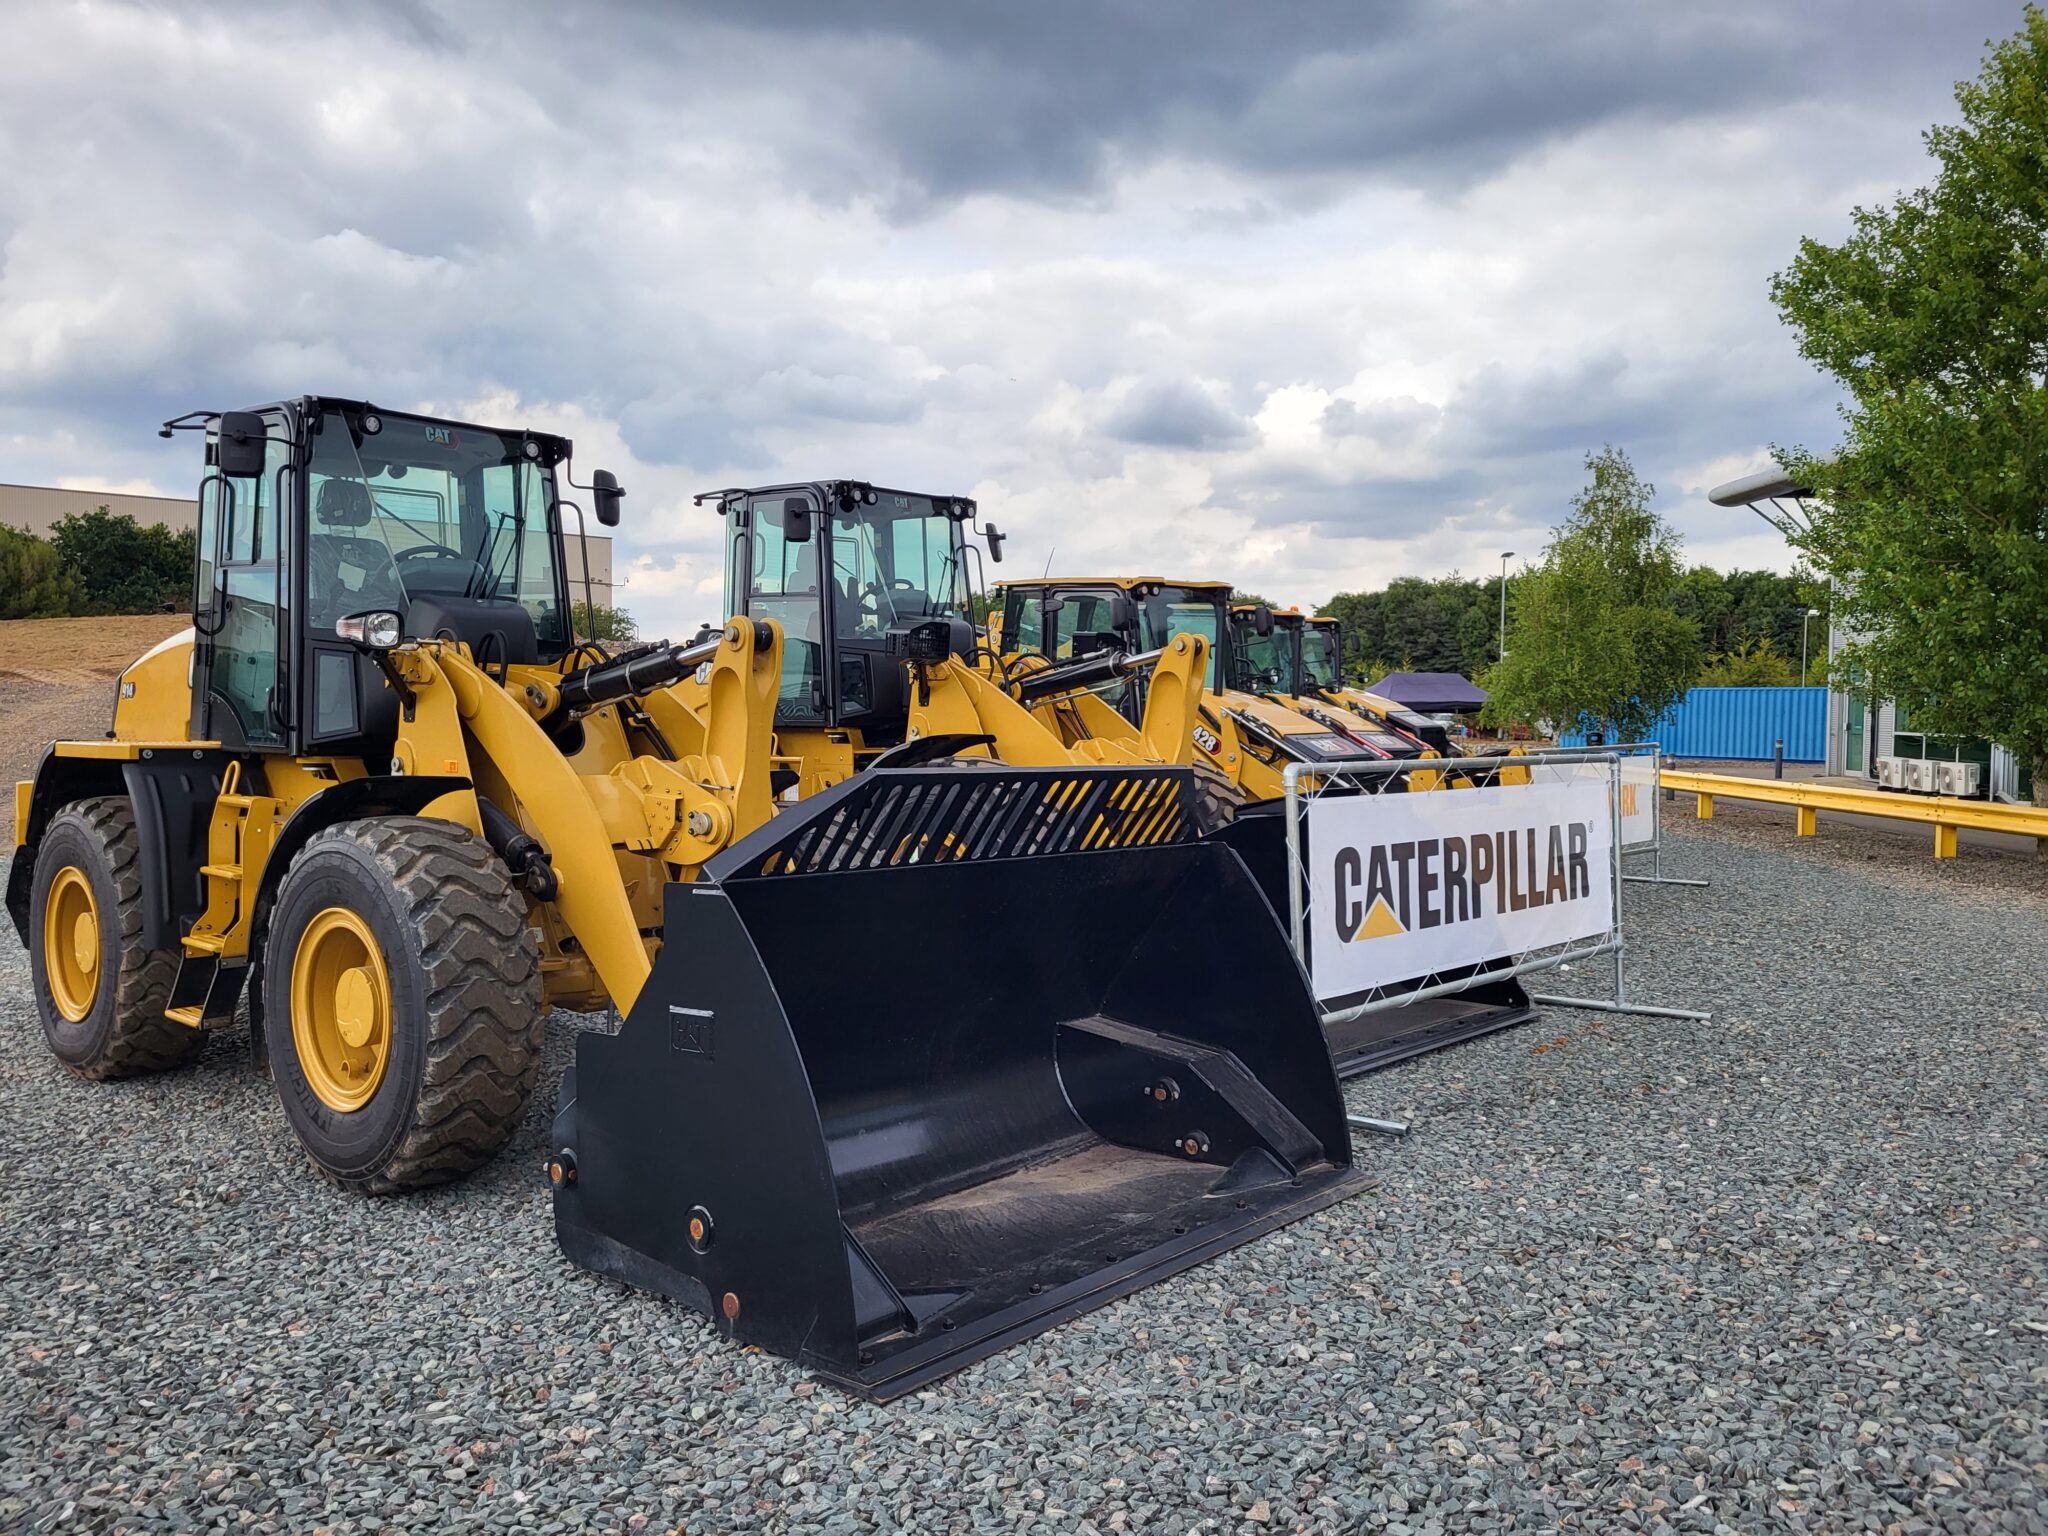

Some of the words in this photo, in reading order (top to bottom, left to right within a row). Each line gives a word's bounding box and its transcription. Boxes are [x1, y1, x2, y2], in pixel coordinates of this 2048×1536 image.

[425, 426, 449, 444] CAT
[895, 496, 908, 508] CAT
[1193, 726, 1217, 752] 428
[1334, 822, 1590, 943] CATERPILLAR
